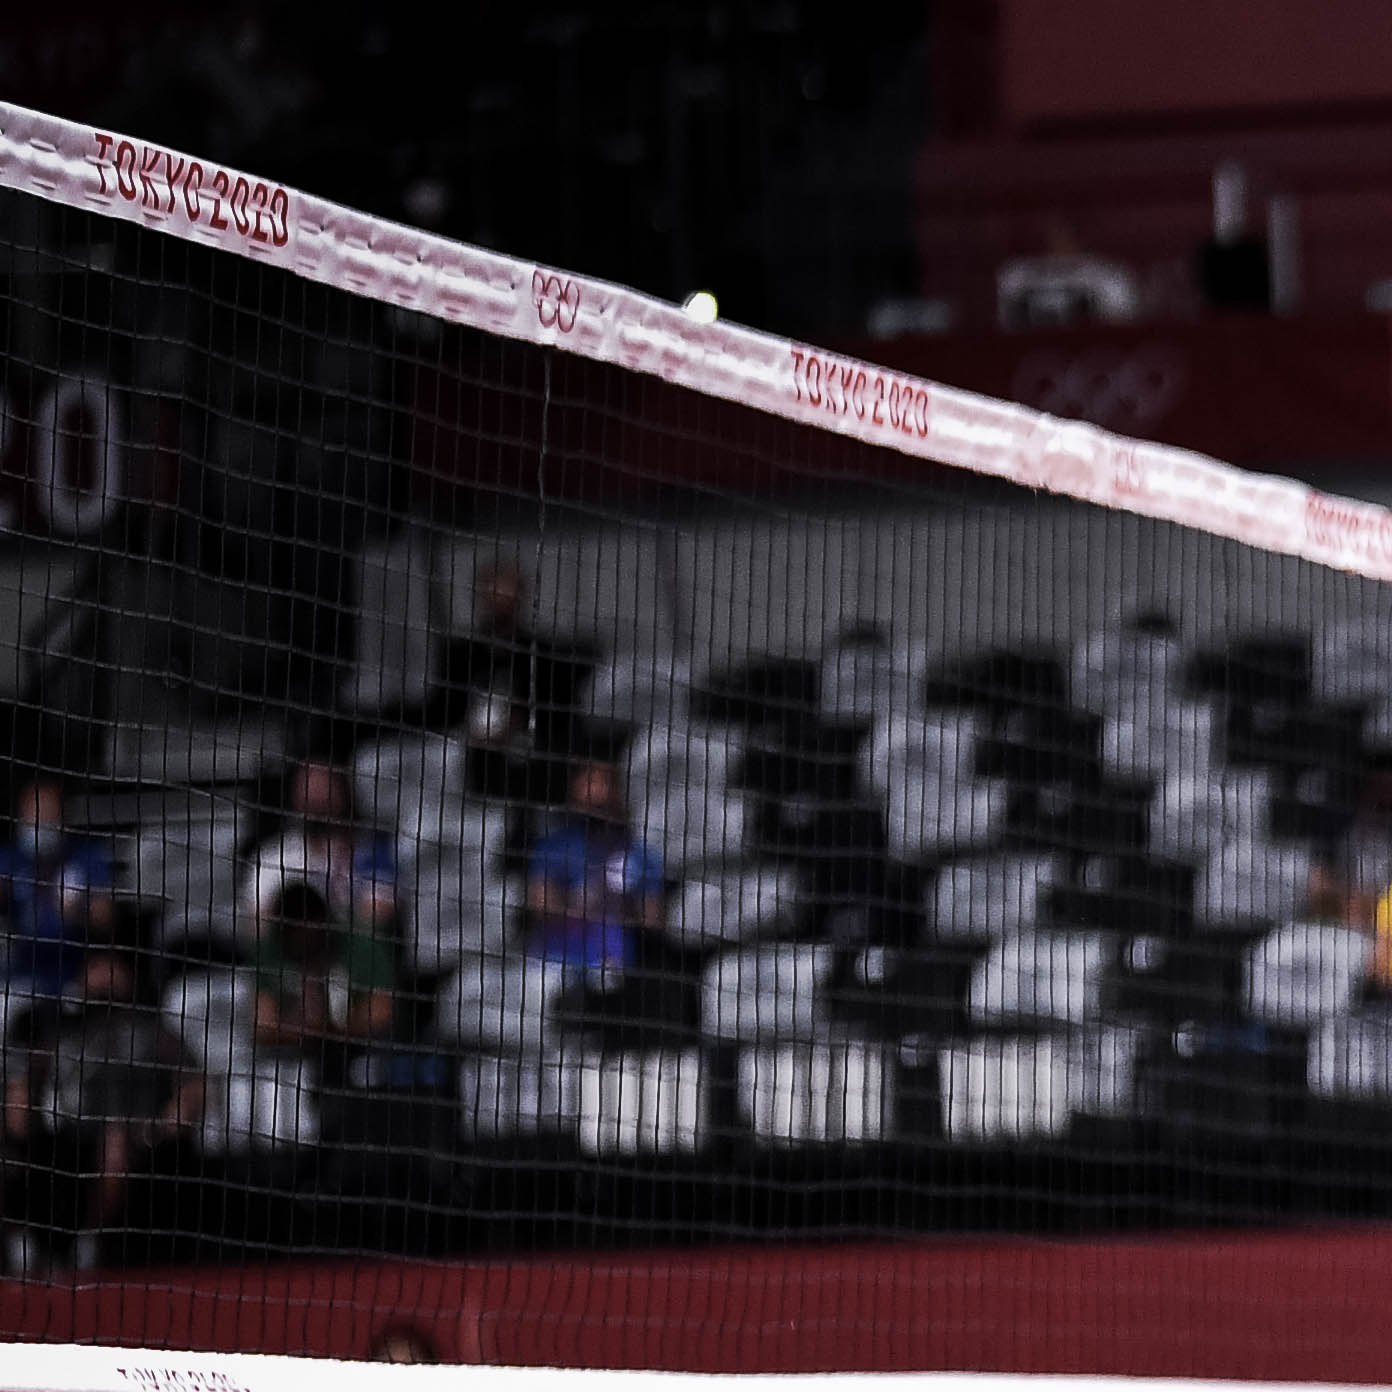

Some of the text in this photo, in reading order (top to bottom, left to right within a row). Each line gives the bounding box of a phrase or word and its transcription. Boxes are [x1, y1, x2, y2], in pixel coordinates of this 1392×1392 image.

[95, 133, 289, 247] TOKYO 2020
[791, 350, 928, 437] TOKYO 2020
